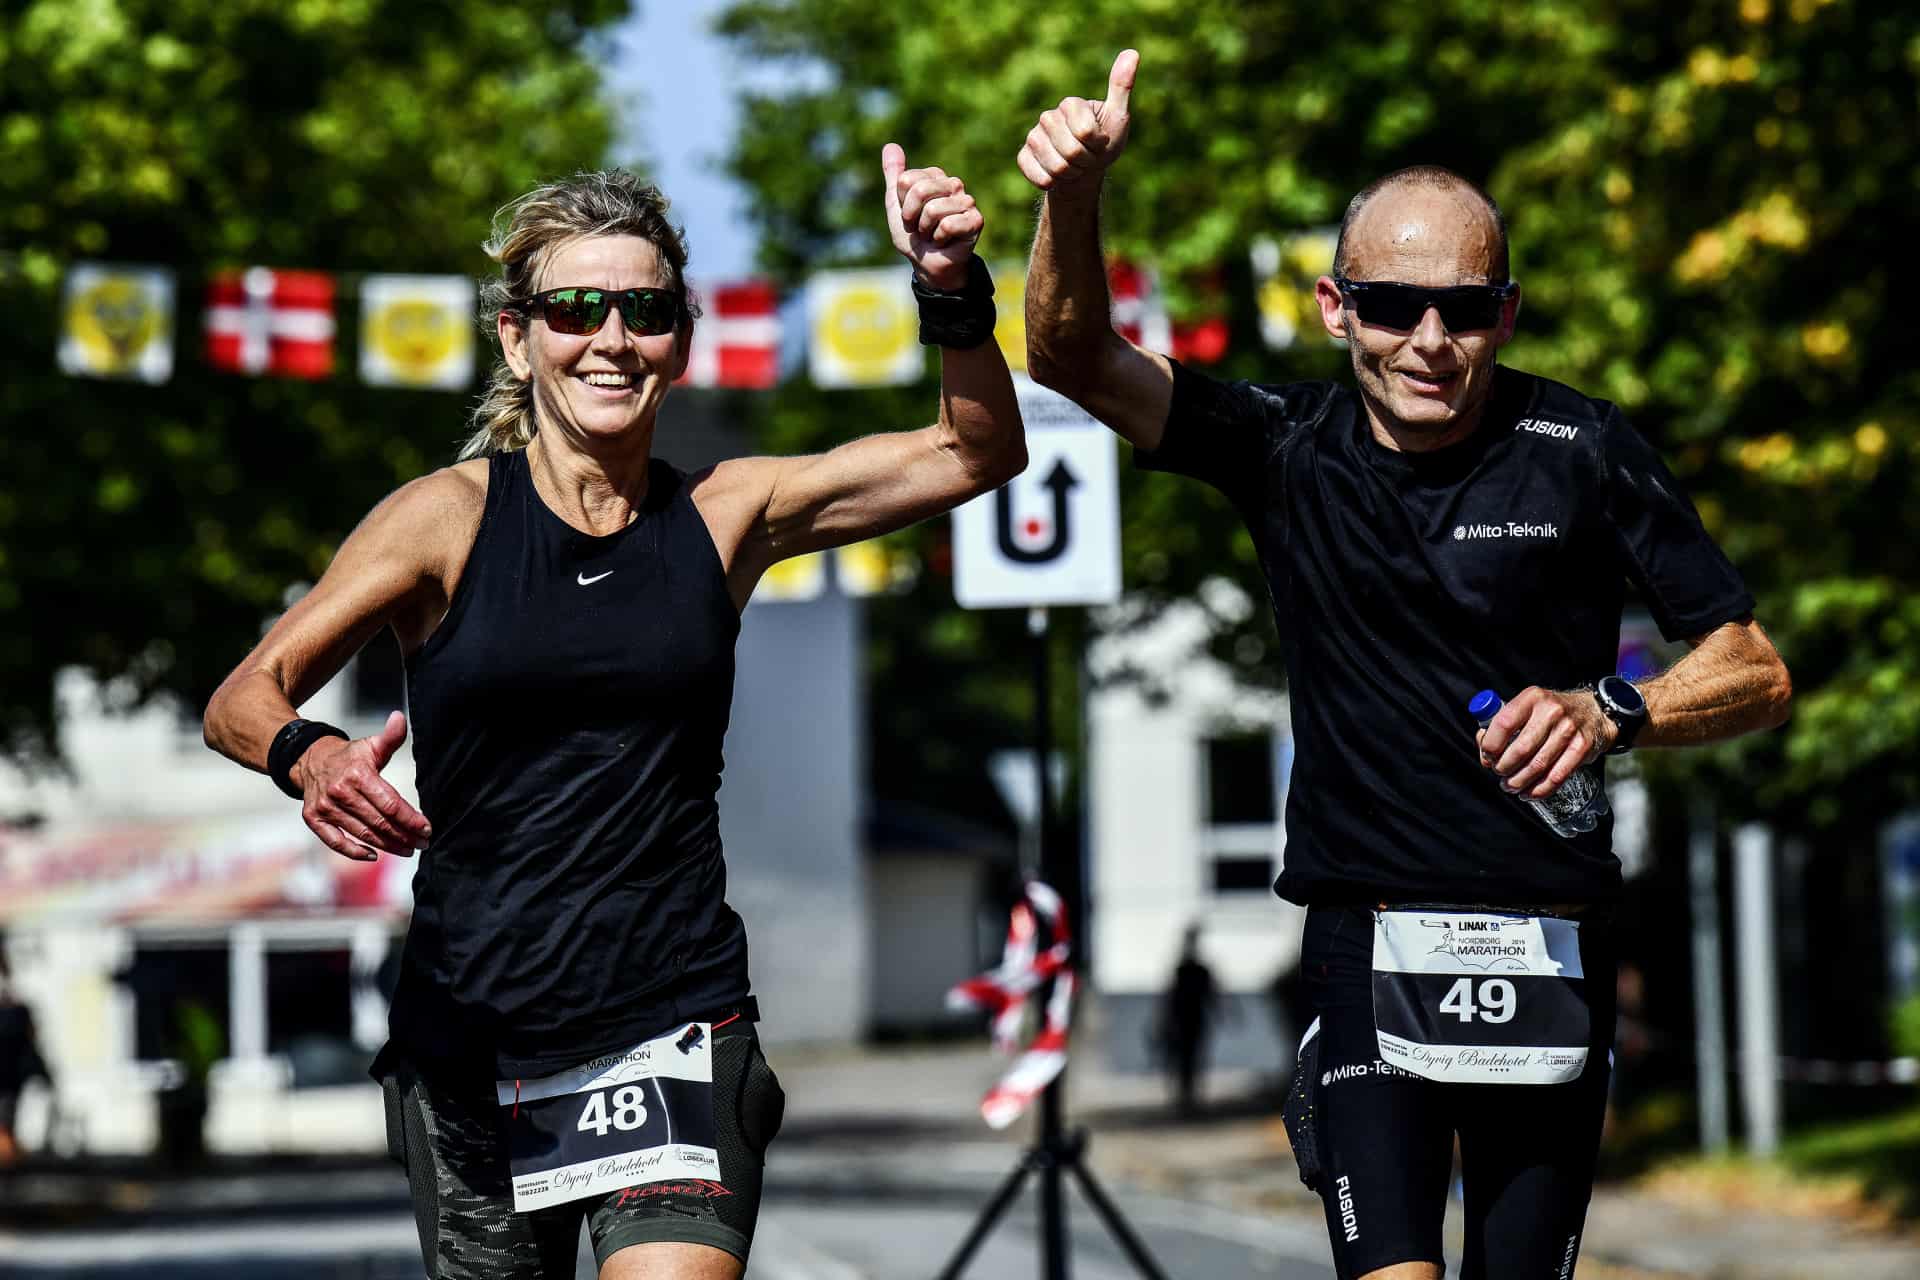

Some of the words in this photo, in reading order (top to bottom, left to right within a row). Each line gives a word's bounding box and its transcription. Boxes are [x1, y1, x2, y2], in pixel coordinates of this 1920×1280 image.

[1515, 418, 1579, 441] FUSION
[1467, 522, 1558, 540] Mita-Teknik
[1458, 921, 1488, 931] LINAK
[1457, 946, 1526, 956] MARATHON
[1439, 977, 1517, 1024] 49
[586, 1051, 651, 1072] MARATHON
[1457, 1048, 1531, 1067] Badehotel
[577, 1085, 648, 1136] 48
[597, 1151, 664, 1178] Badehotel
[1336, 1175, 1360, 1242] FUSION
